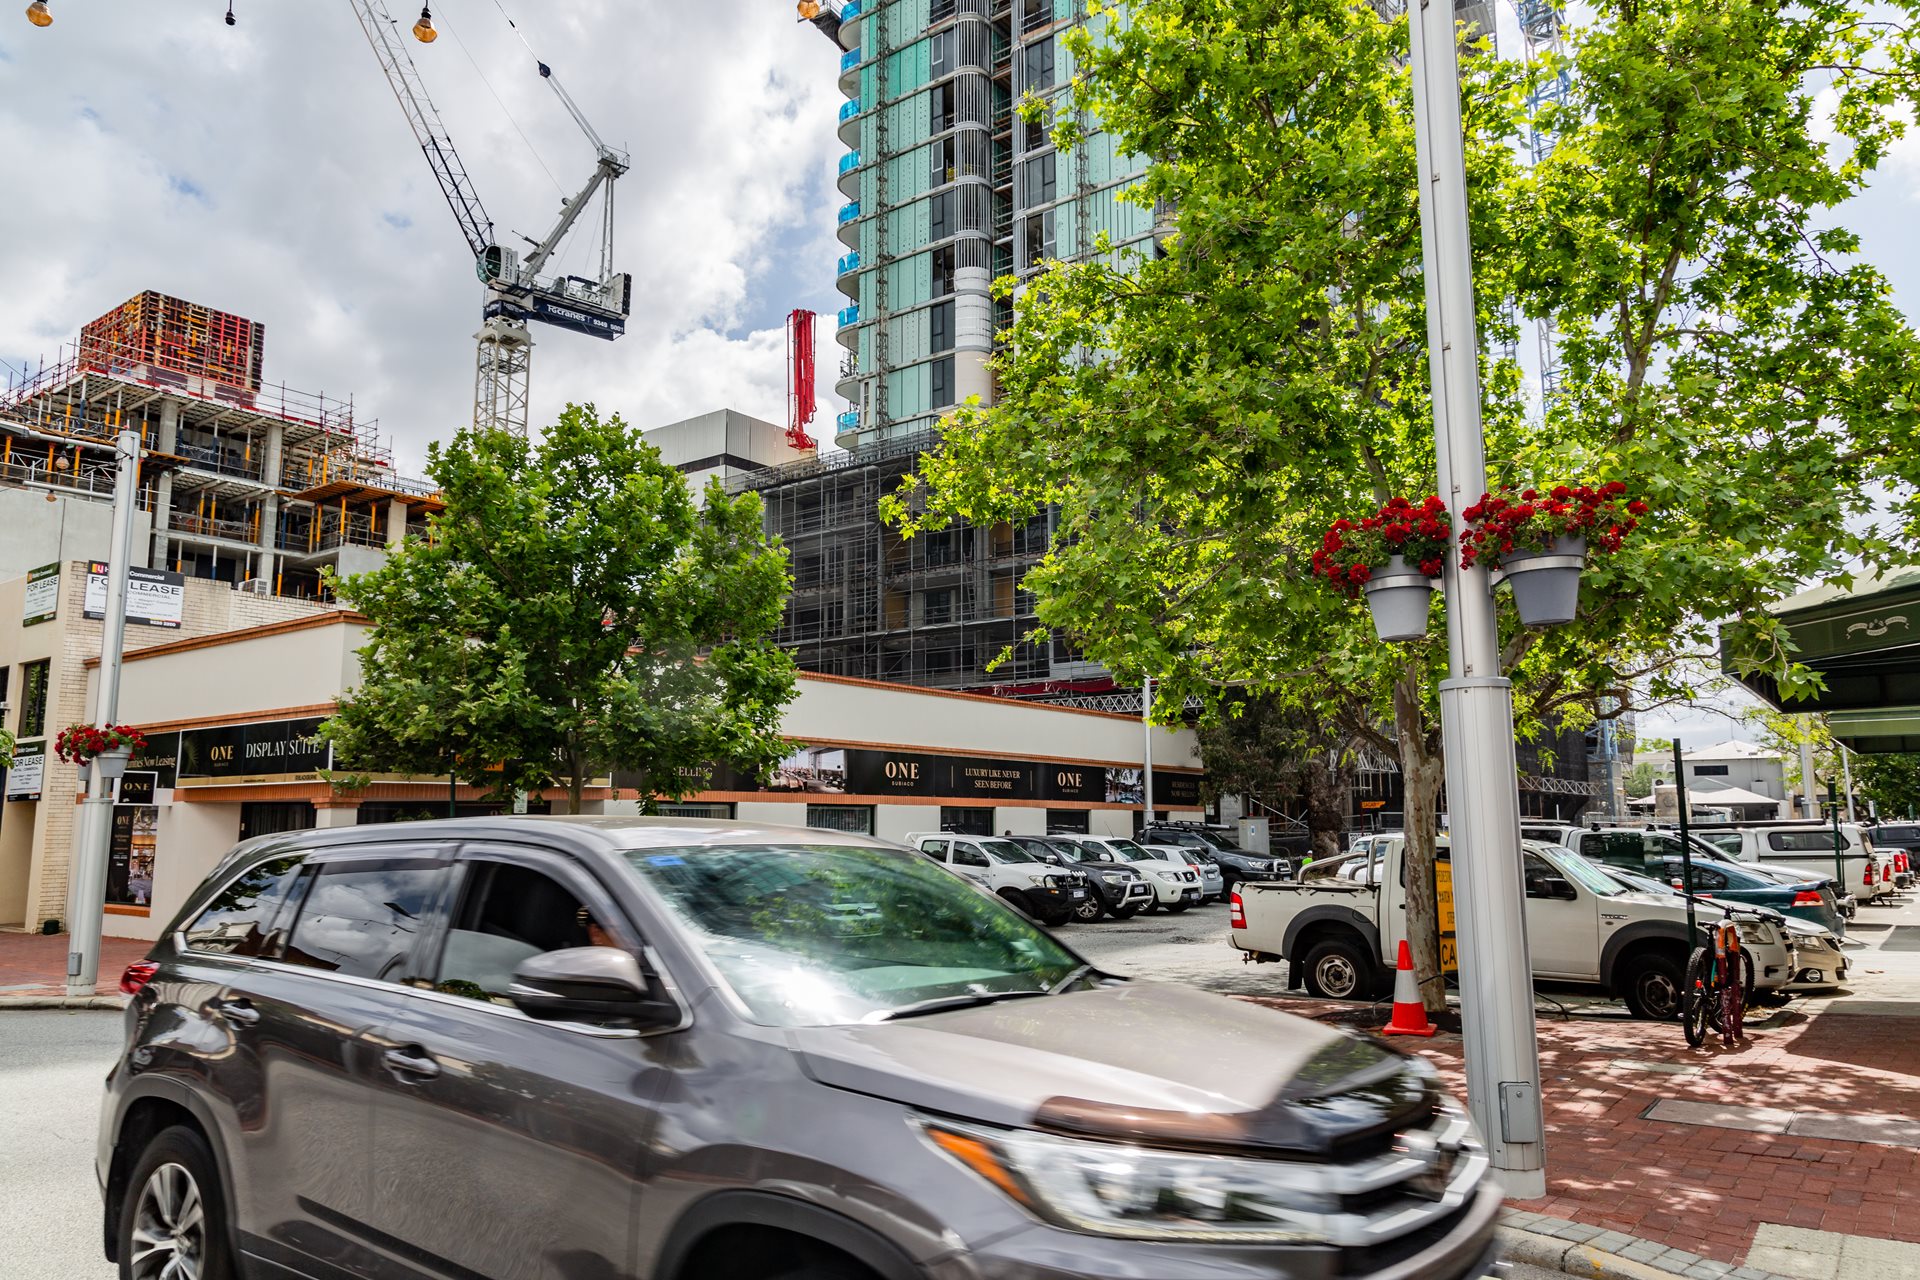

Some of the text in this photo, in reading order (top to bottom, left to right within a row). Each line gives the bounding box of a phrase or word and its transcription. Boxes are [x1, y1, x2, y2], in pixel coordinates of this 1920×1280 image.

[129, 570, 165, 580] Commercial
[27, 582, 39, 592] FOR
[39, 576, 58, 589] LEASE
[130, 581, 180, 596] LEASE
[210, 745, 234, 761] ONE
[246, 740, 287, 759] DISPLAY
[25, 756, 43, 766] LEASE
[885, 761, 920, 779] ONE
[965, 768, 1021, 779] LUXURY LIKE NEVER
[974, 780, 1012, 790] SEEN BEFORE
[1057, 772, 1083, 787] ONE
[124, 782, 150, 792] ONE
[117, 816, 130, 825] ONE
